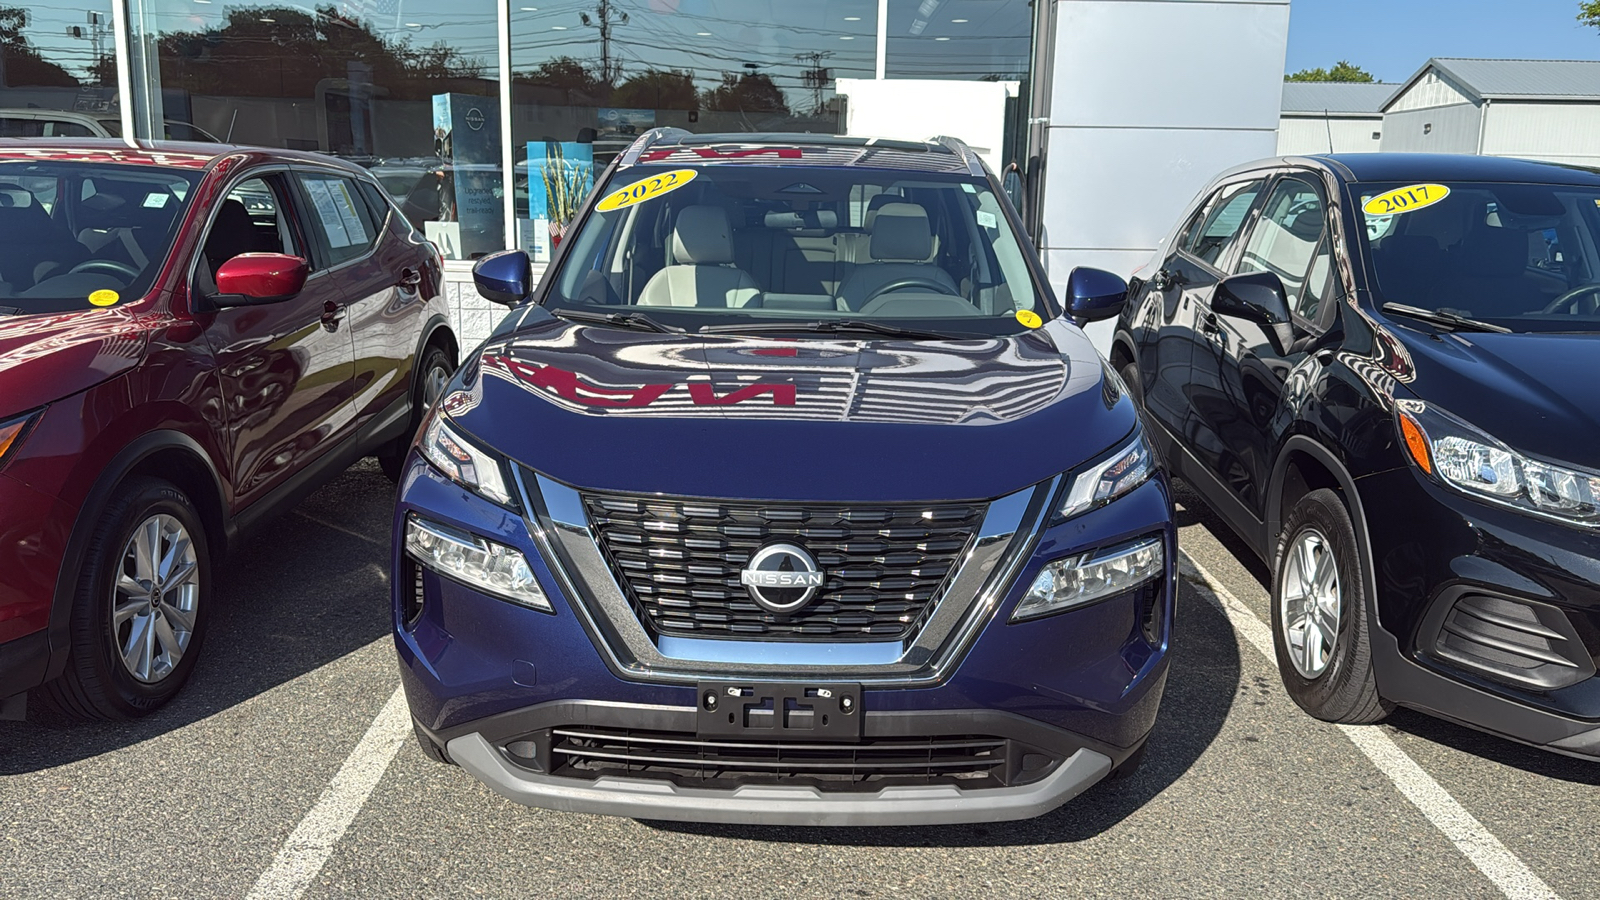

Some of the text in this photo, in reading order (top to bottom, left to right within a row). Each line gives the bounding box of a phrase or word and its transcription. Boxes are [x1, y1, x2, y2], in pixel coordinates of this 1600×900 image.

[616, 174, 678, 206] 2022
[1378, 186, 1429, 212] 2017
[744, 573, 821, 585] NISSAN
